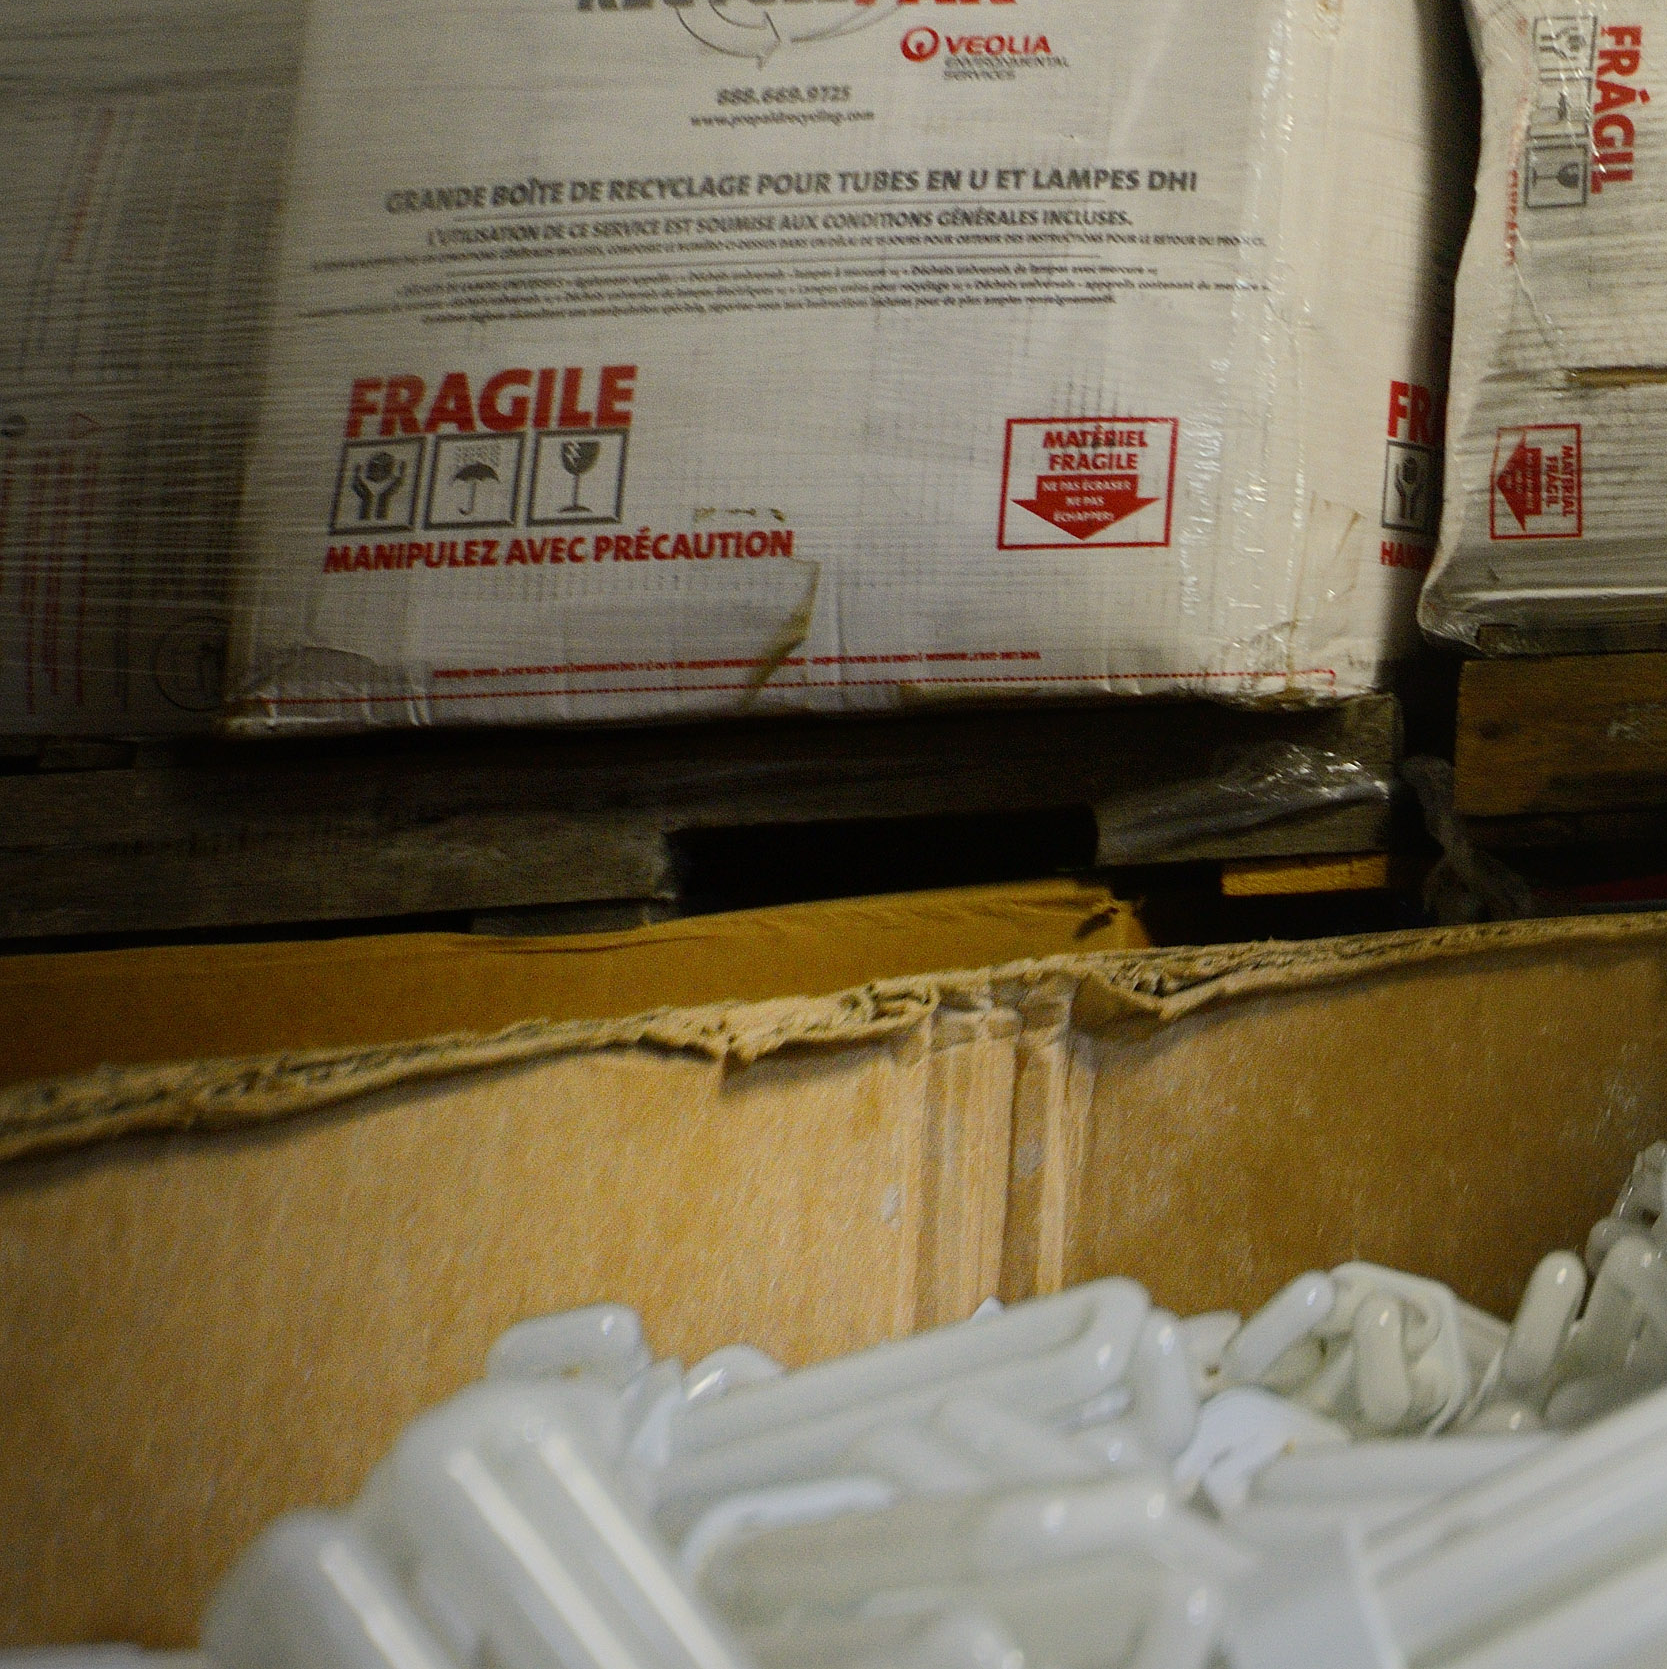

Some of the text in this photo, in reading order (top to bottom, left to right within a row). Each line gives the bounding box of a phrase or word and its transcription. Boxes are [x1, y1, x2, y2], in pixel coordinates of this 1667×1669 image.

[945, 34, 1053, 55] VEOLIA
[1590, 24, 1650, 194] FRÁGIL
[383, 184, 489, 214] GRANDE
[491, 176, 564, 207] BOÎTE
[569, 179, 600, 204] DE
[607, 172, 751, 202] RECYCLAGE
[753, 170, 833, 197] POUR
[838, 170, 920, 193] TUBES
[925, 169, 963, 192] EN
[967, 169, 990, 192] U
[999, 168, 1027, 191] ET
[1033, 168, 1140, 191] LAMPES
[822, 208, 933, 230] CONDITIONS
[1042, 207, 1134, 227] INCLUSES.
[345, 365, 638, 438] FRAGILE
[1042, 423, 1149, 449] MATÉRIEL
[1049, 452, 1139, 471] FRAGILE
[1561, 445, 1575, 517] MATERIAL
[323, 526, 794, 573] MANIPULEZ AVEC PRÉCAUTION
